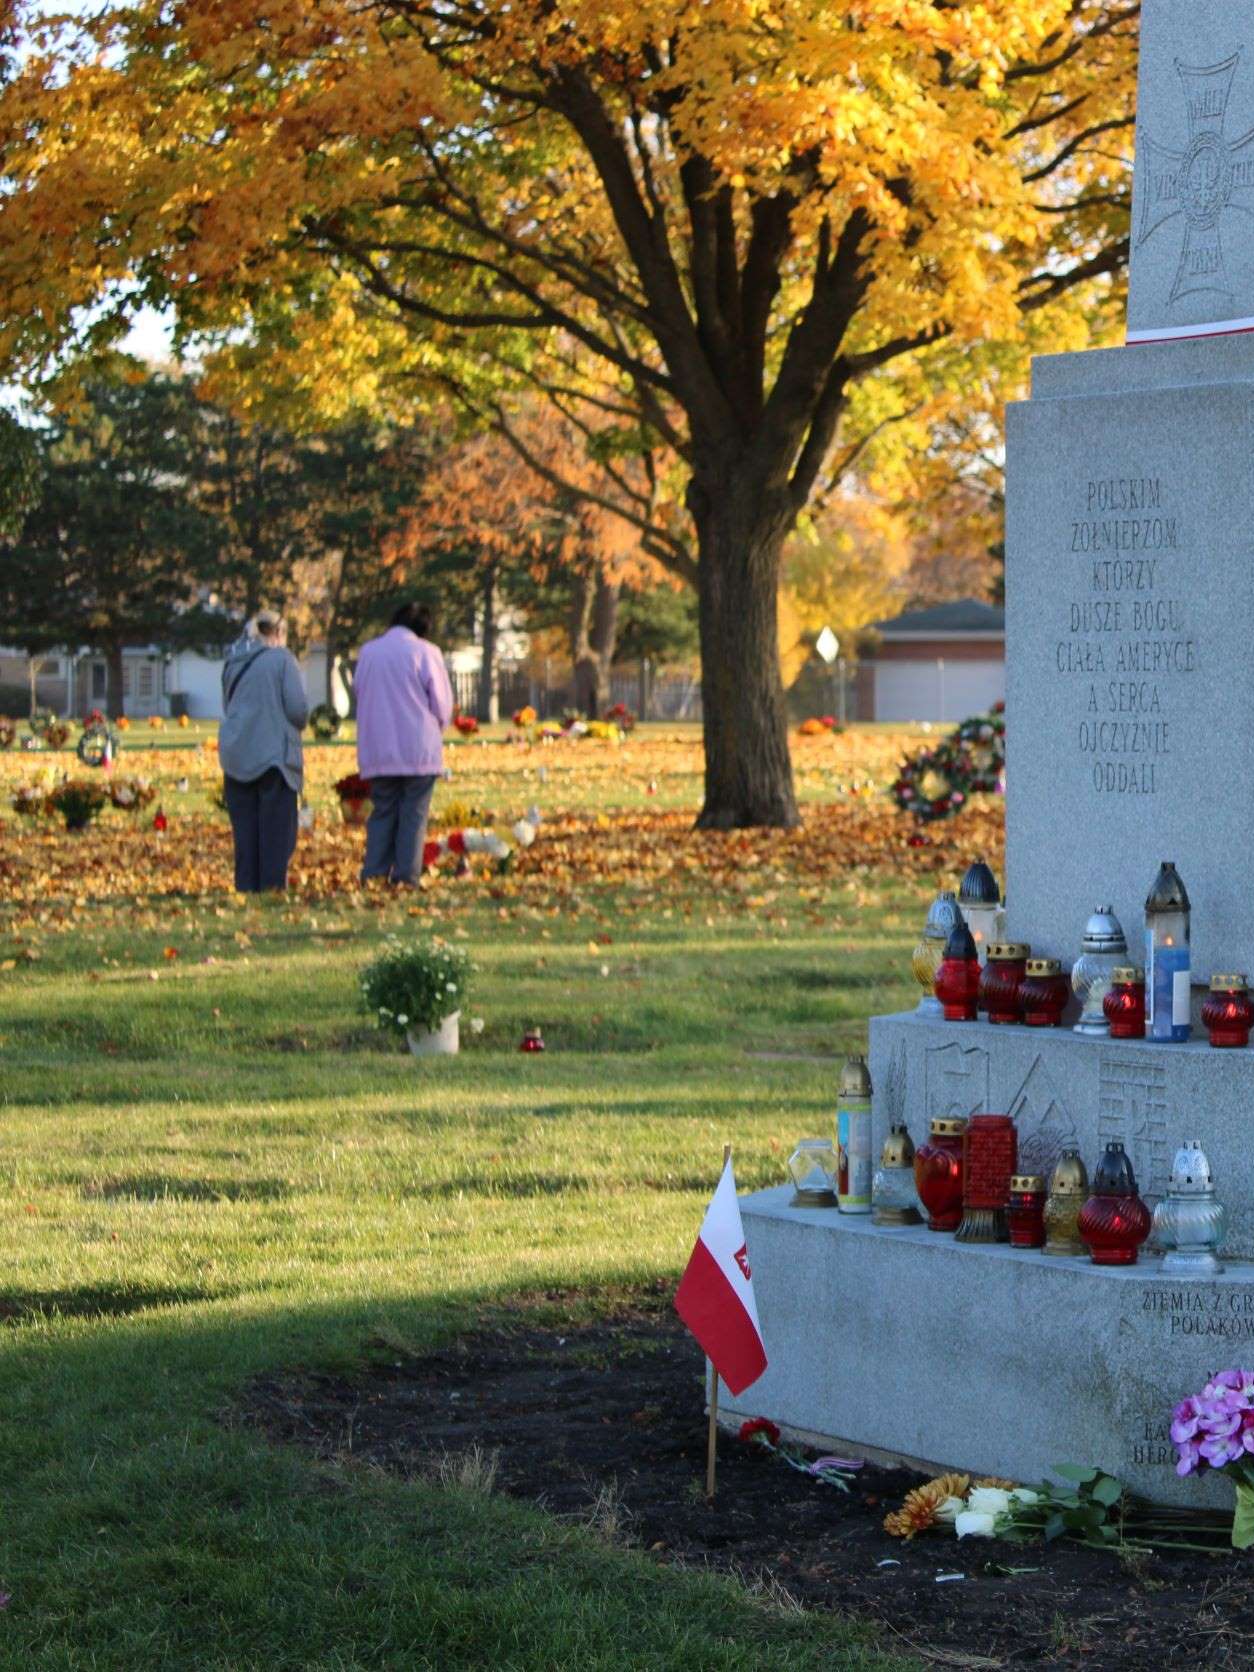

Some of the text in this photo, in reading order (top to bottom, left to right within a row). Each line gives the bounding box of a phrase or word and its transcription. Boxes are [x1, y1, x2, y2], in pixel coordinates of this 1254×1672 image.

[1088, 478, 1160, 511] POLSKIM
[1071, 602, 1122, 632] DUSZE
[1056, 641, 1194, 672] CIAŁA AMERYCE
[1088, 682, 1160, 712] A SERCA
[1093, 762, 1156, 793] ODDALI
[1143, 1291, 1203, 1312] ZIEMIA
[1213, 1294, 1223, 1312] Z
